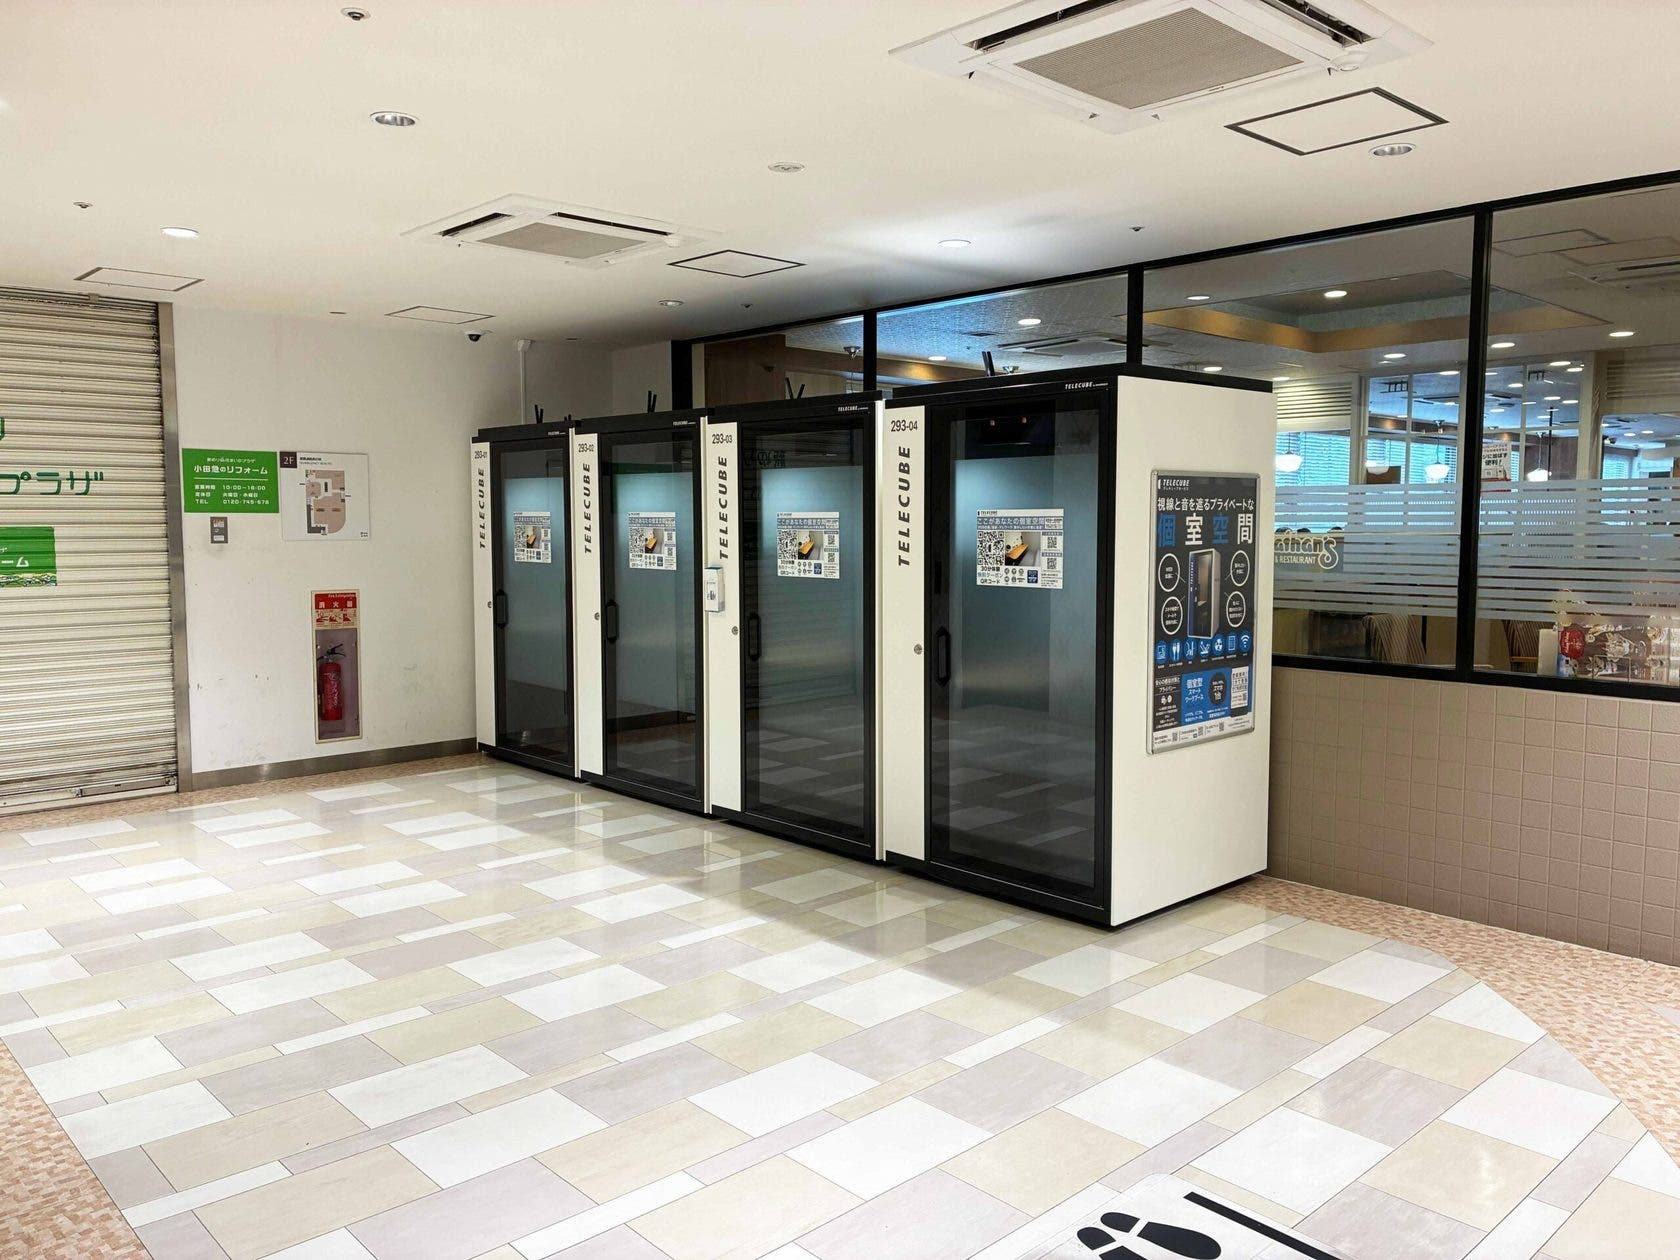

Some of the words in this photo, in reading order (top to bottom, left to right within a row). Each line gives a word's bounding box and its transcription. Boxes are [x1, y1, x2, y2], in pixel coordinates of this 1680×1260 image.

[890, 420, 918, 432] 293-04
[712, 433, 733, 444] 293-03
[578, 443, 594, 453] 293-02
[283, 456, 295, 465] 2F
[474, 450, 488, 459] 293-01
[193, 464, 268, 475] 小田急のリフォーム
[0, 470, 104, 495] プラザ
[1162, 479, 1190, 487] TELECUBE
[477, 468, 486, 549] TELECUBE
[582, 463, 592, 554] TELECUBE
[718, 455, 729, 560] TELECUBE
[898, 446, 911, 567] TELECUBE
[1157, 497, 1255, 511] 視線と音を遮るプライベートな
[1158, 512, 1254, 547] 個室空間
[1280, 555, 1316, 564] RESTAURANT
